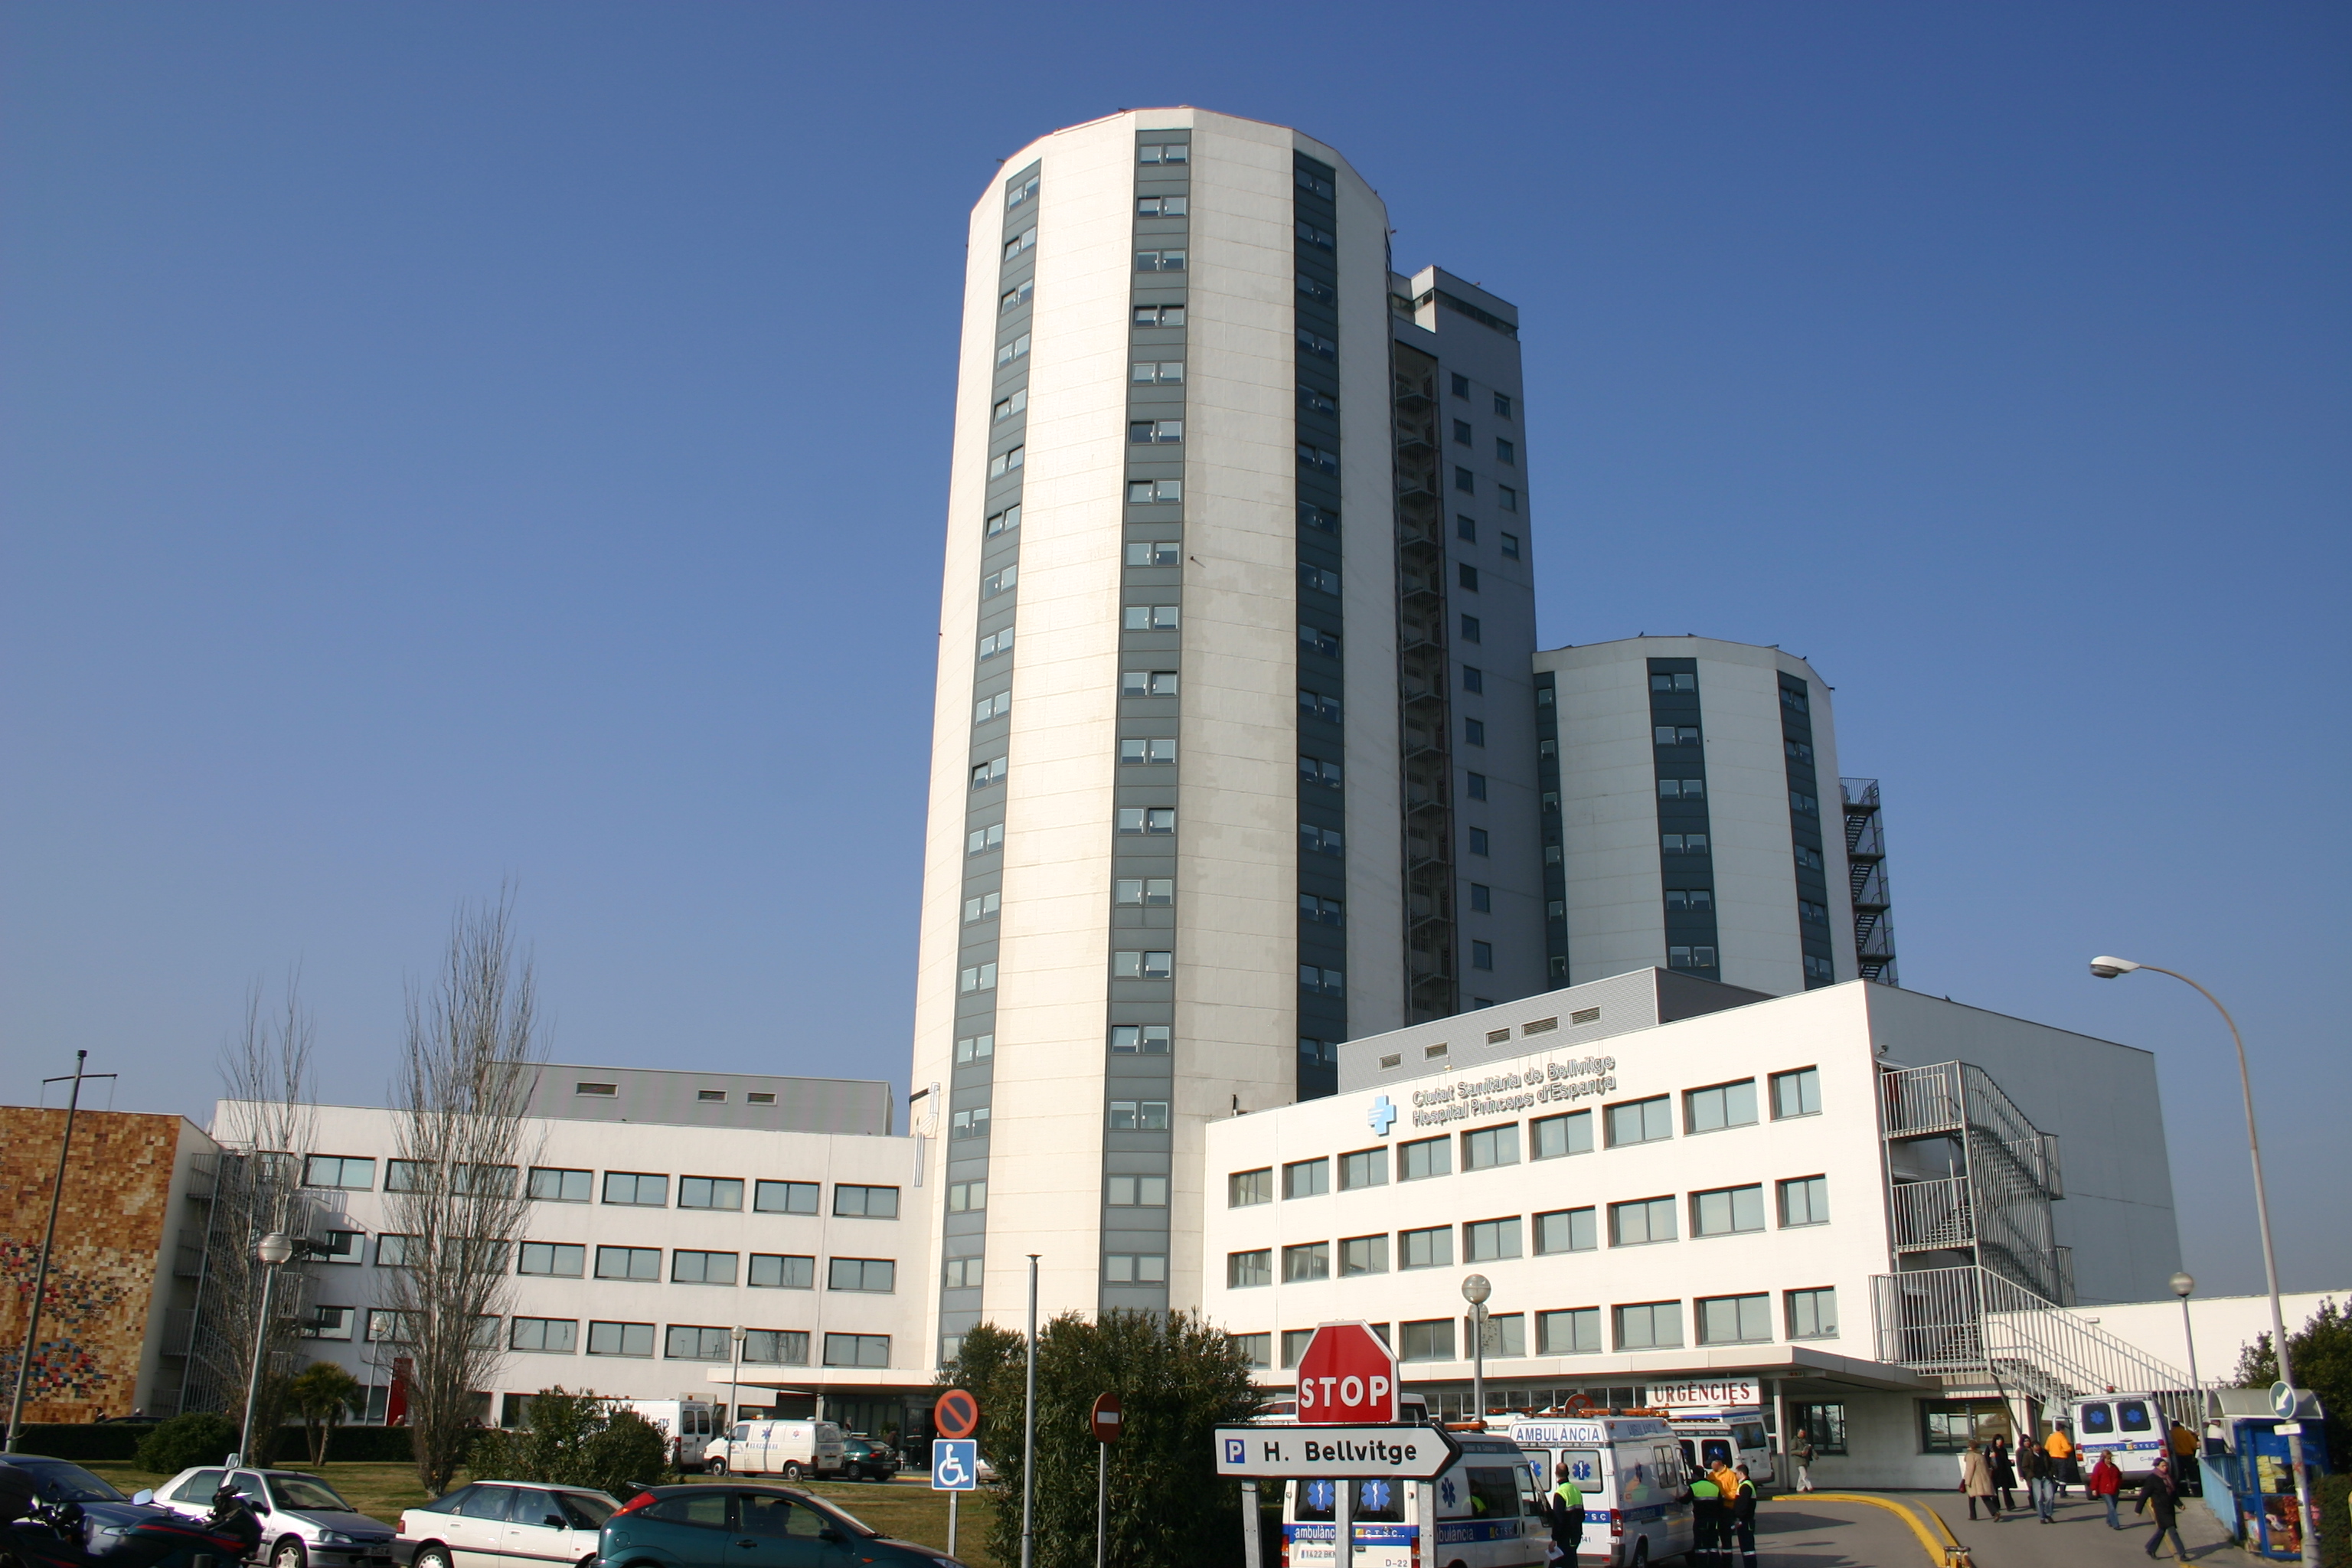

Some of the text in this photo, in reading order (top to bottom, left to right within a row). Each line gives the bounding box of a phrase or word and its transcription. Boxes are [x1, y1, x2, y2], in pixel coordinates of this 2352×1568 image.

[1413, 1085, 1455, 1107] Ciutat
[1524, 1067, 1544, 1086] de
[1547, 1056, 1615, 1081] Bellvitge
[1413, 1100, 1469, 1127] Hospital
[1300, 1375, 1390, 1409] STOP
[1654, 1381, 1750, 1403] URGÈNCIES
[1516, 1424, 1600, 1441] AMBULÀNCIA
[1264, 1441, 1289, 1462] H.
[1305, 1439, 1417, 1465] Bellvitge
[1295, 1525, 1335, 1539] ambulànc
[1385, 1559, 1408, 1567] D-22
